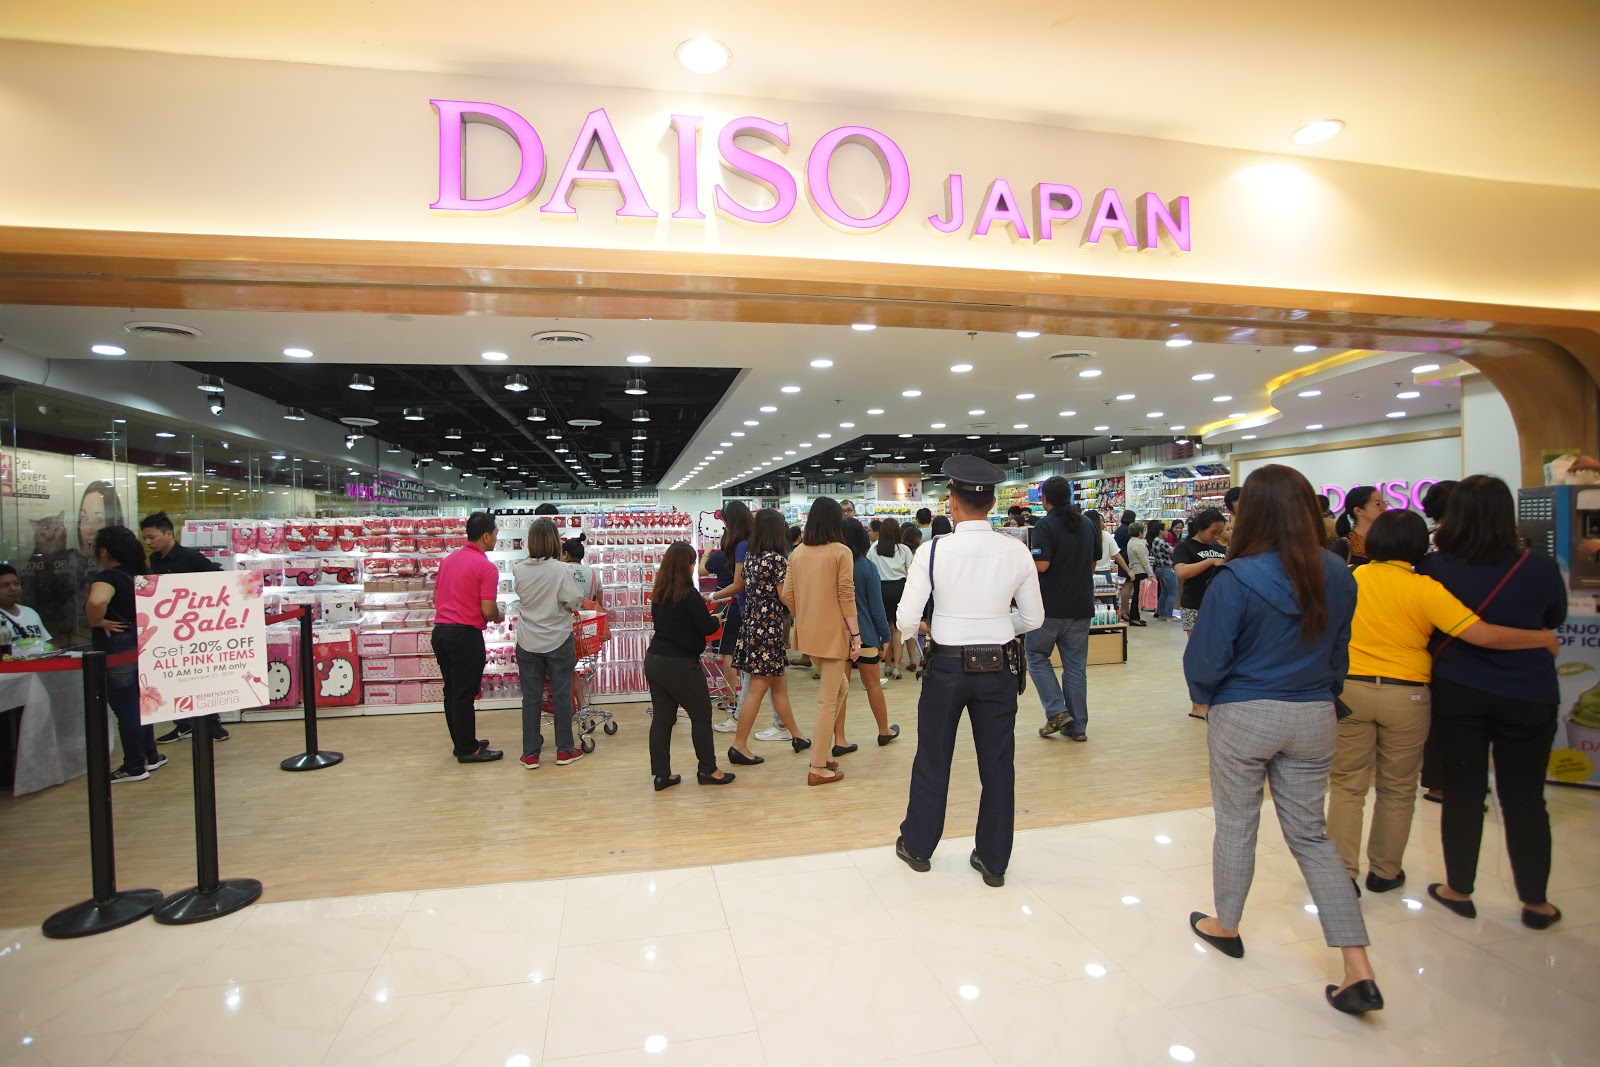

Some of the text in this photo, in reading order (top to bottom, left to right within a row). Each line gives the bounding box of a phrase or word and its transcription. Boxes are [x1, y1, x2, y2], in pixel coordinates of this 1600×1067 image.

[429, 99, 1191, 253] DAISO JAPAN
[154, 585, 231, 619] Pink
[173, 608, 250, 641] Sale!
[1557, 624, 1600, 635] ENJO
[152, 637, 254, 658] Get 20% OFF
[1556, 635, 1575, 647] OF
[153, 649, 255, 670] ALL PINK ITEMS
[176, 668, 191, 677] AM
[194, 667, 203, 675] to
[213, 664, 227, 672] PM
[228, 662, 247, 671] only
[177, 674, 210, 683] September
[196, 689, 239, 699] ROBINSONS
[196, 695, 240, 709] Galleria
